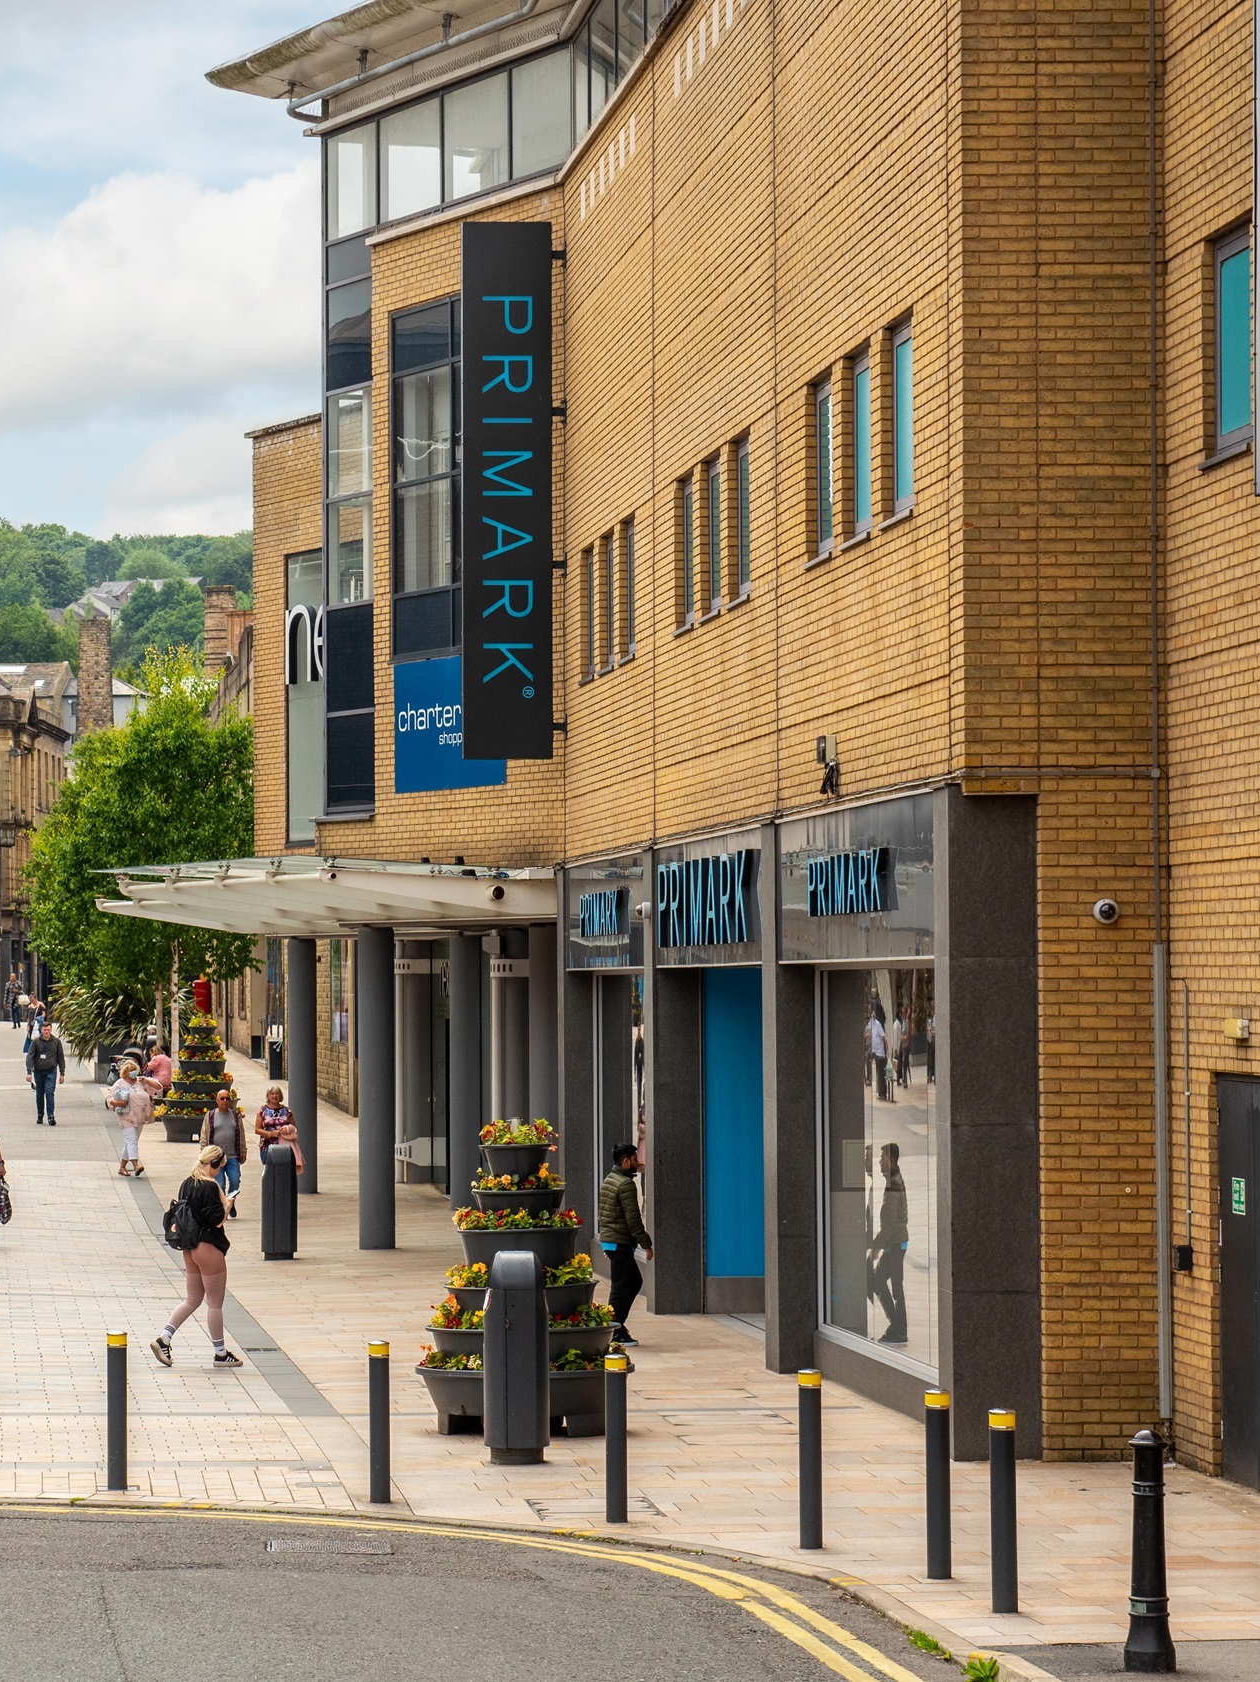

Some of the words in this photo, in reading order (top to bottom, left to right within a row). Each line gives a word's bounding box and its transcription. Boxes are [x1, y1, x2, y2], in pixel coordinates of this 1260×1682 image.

[398, 703, 462, 732] charter
[658, 849, 748, 948] PRIMARK
[807, 848, 881, 917] PRIMARK
[579, 890, 618, 937] PRIMARK
